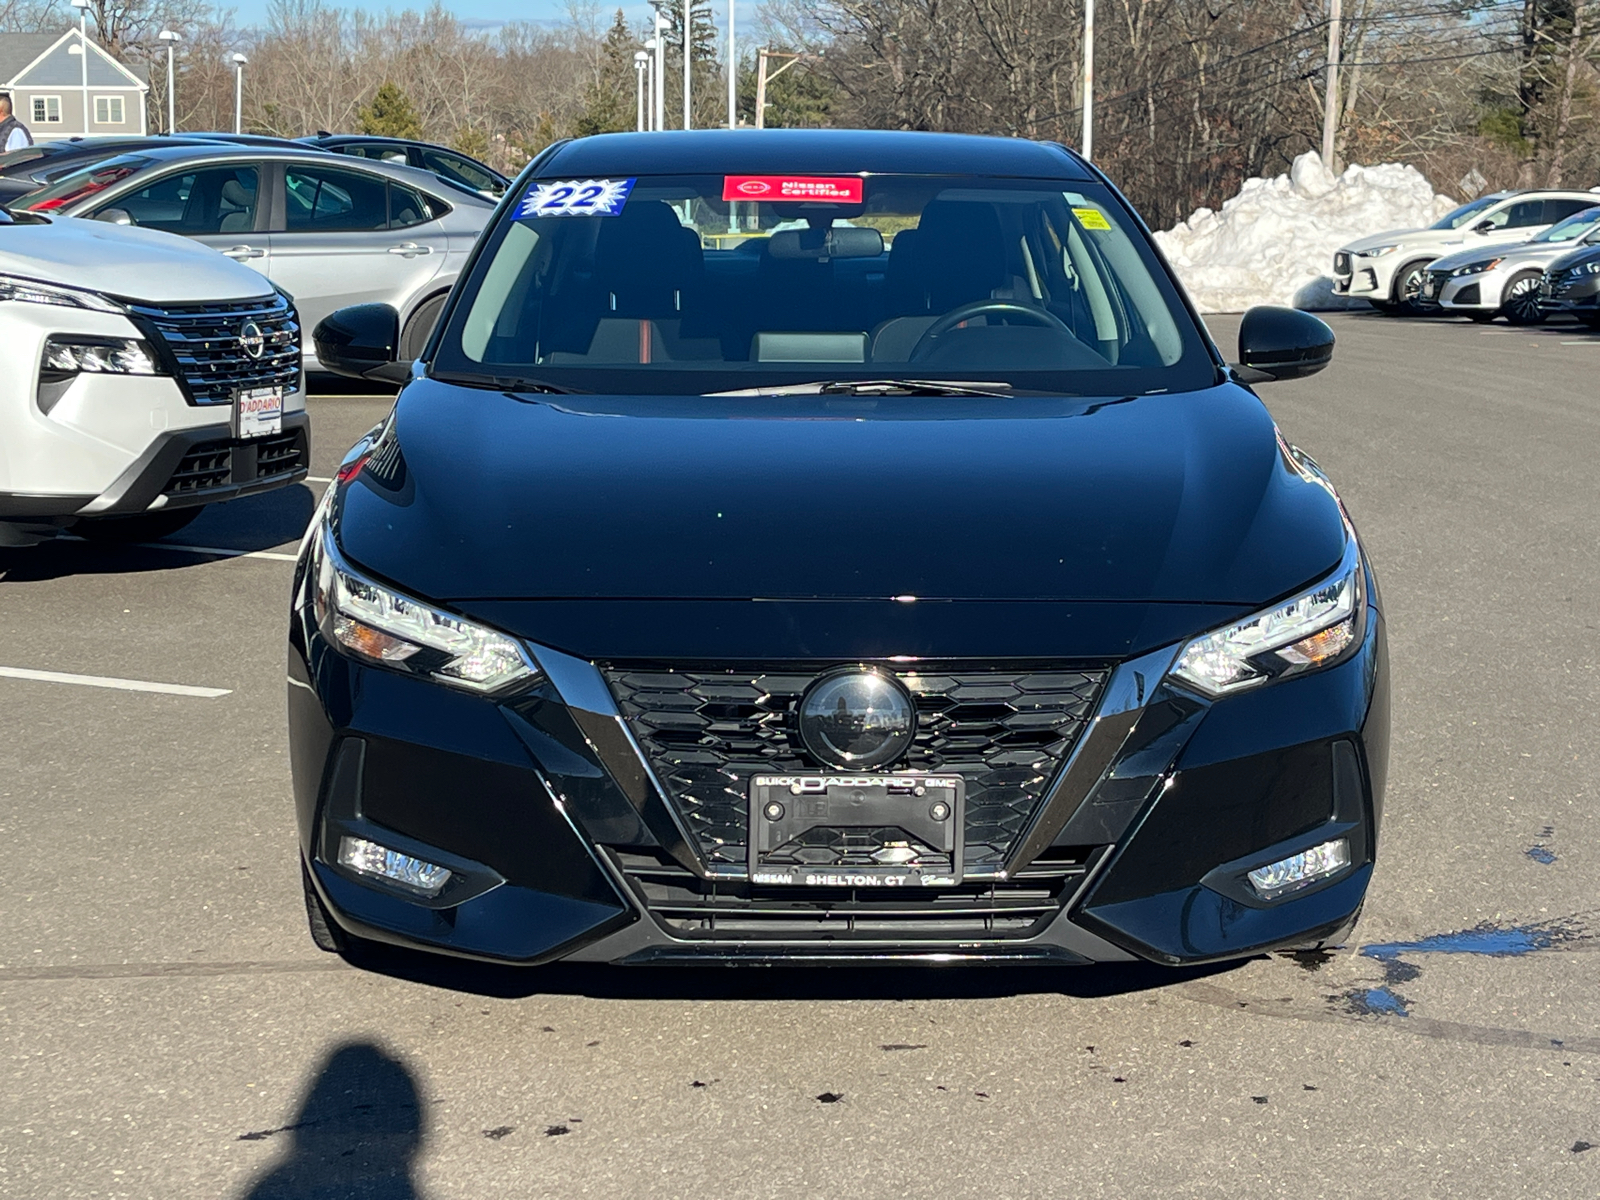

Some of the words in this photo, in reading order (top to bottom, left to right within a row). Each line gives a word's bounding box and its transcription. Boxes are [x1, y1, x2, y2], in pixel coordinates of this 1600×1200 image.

[781, 181, 836, 189] Nissan
[541, 185, 605, 208] 22
[781, 188, 850, 196] Certified
[240, 397, 281, 414] D'ADDARIO
[756, 776, 798, 786] BUICK
[800, 776, 916, 791] D'ADDARIO
[925, 779, 956, 787] GMC
[752, 873, 792, 884] NISSAN
[884, 875, 906, 886] CT
